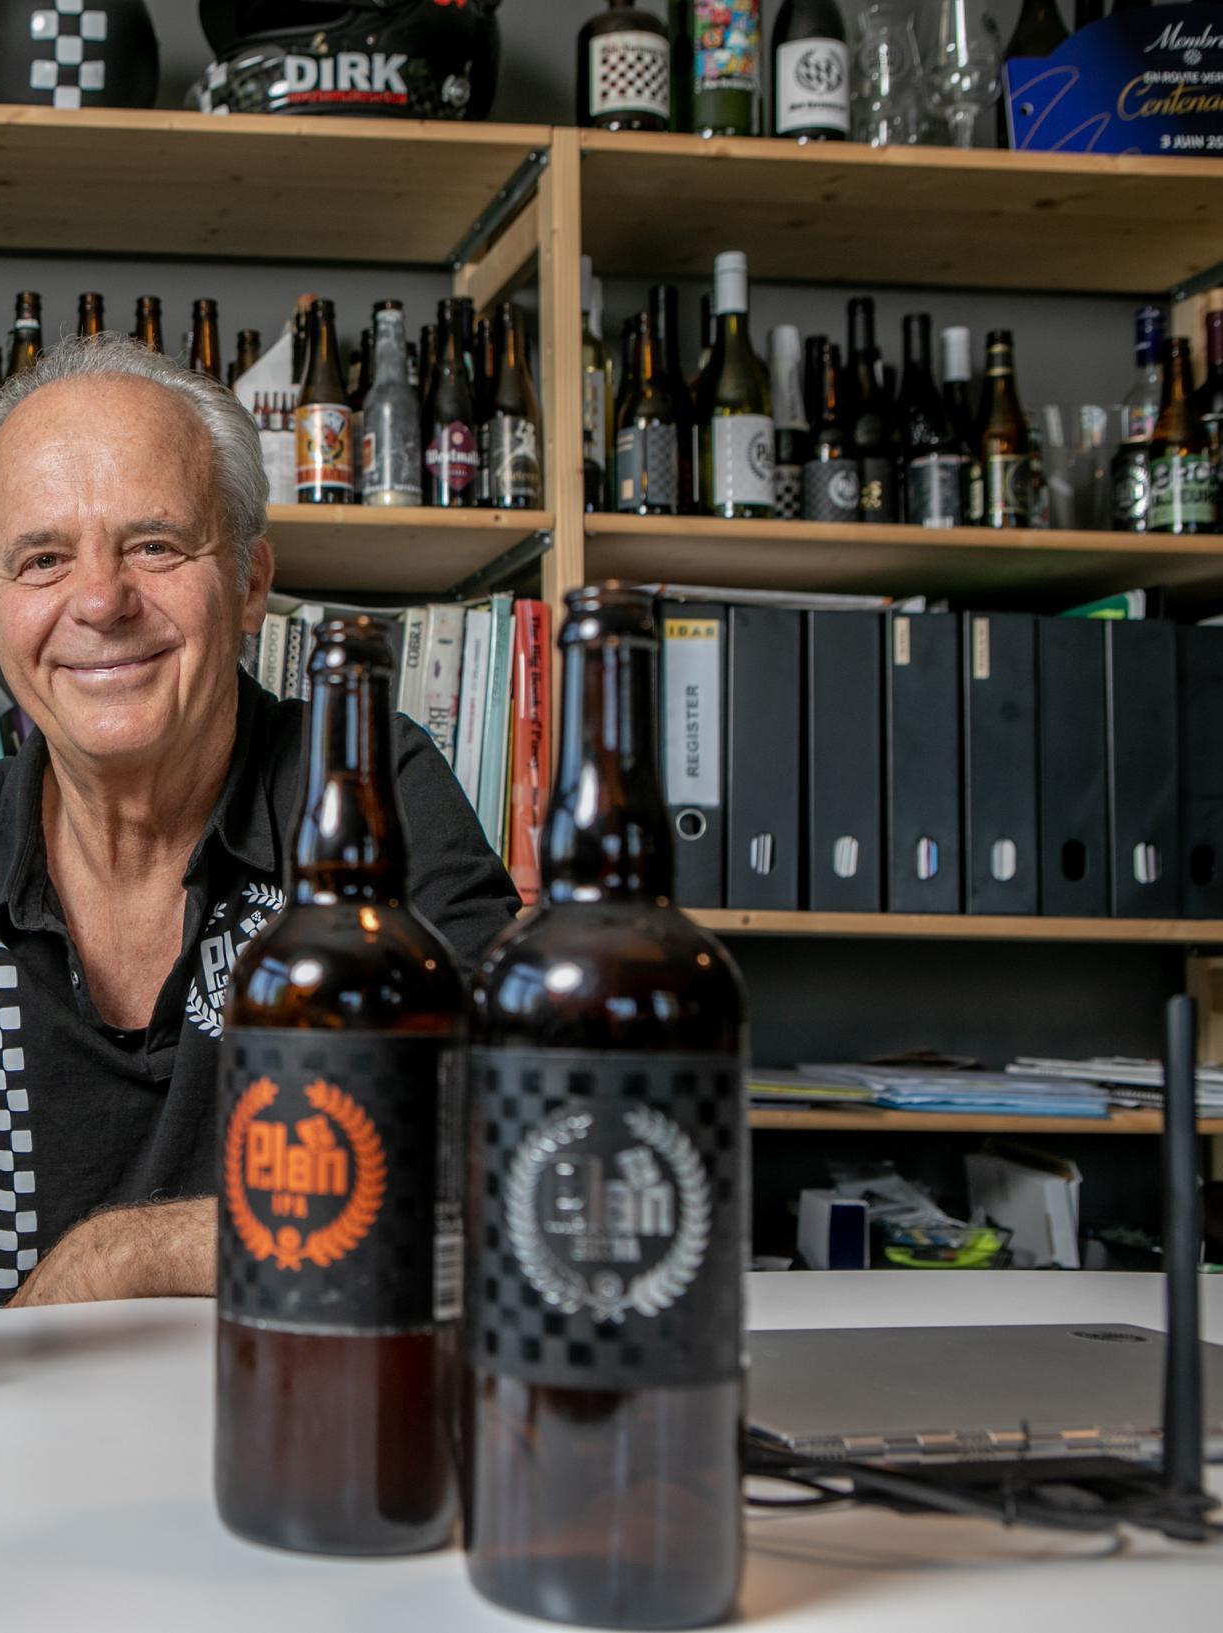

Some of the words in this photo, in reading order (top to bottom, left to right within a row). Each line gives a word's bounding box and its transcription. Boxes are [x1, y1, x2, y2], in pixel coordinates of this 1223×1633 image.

[1163, 71, 1200, 84] ROUTE
[1173, 134, 1205, 149] JUIN
[407, 620, 423, 668] COBRA
[686, 685, 699, 778] REGISTER
